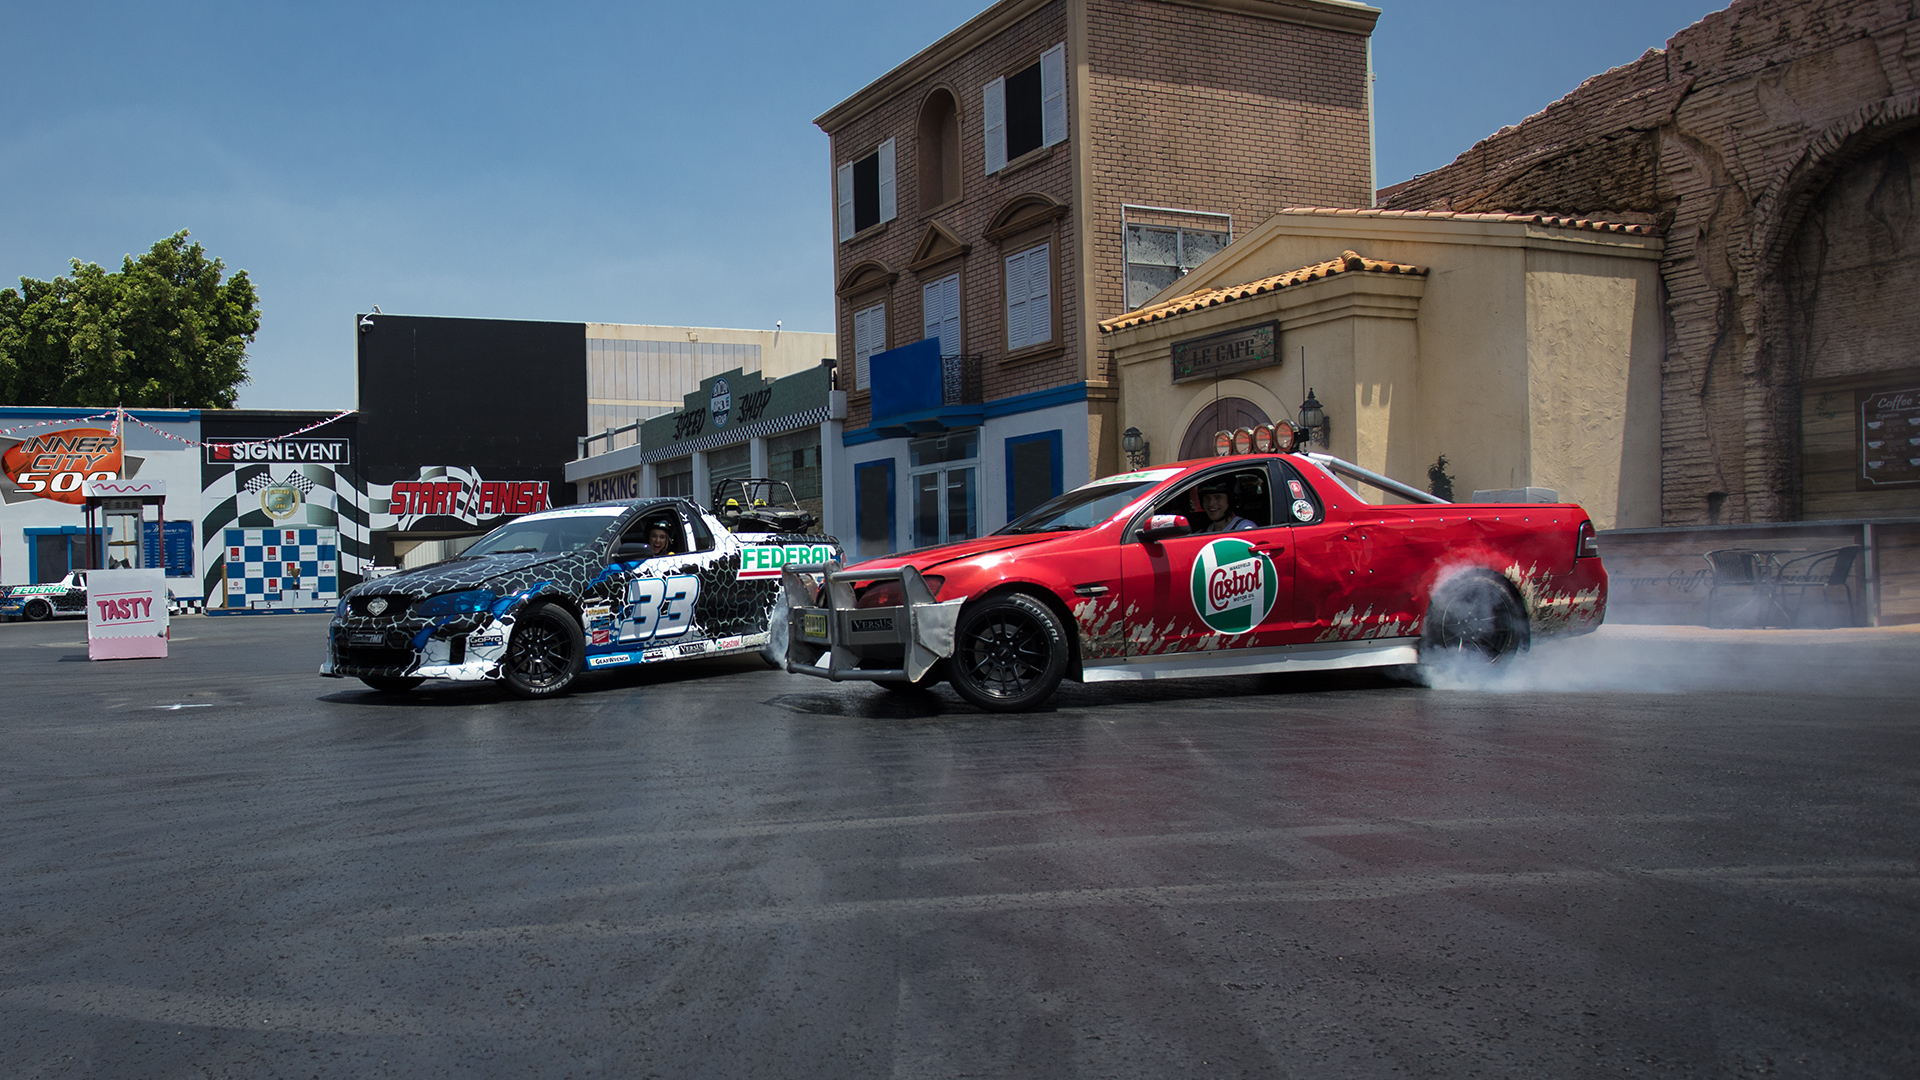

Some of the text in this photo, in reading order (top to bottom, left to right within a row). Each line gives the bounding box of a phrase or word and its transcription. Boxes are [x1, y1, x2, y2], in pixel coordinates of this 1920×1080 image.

[1193, 339, 1255, 366] LE CAFE
[1877, 394, 1912, 410] Coffee
[672, 407, 706, 440] SPEED
[737, 387, 772, 423] SHOP
[20, 436, 119, 453] INNER
[31, 454, 107, 470] CITY
[588, 471, 638, 502] PARKING
[389, 482, 463, 515] START
[478, 482, 549, 515] FINISH
[1229, 562, 1251, 571] WAKEFIELD
[12, 586, 67, 595] FEDERAL
[295, 591, 299, 599] 1
[1209, 560, 1262, 611] Castrol
[97, 597, 152, 621] TASTY
[323, 599, 329, 607] 2
[618, 575, 700, 645] 33
[1015, 600, 1060, 644] FEDERAL
[470, 636, 502, 644] GoPro
[722, 639, 740, 649] Castrol
[529, 672, 574, 693] FEDERAL
